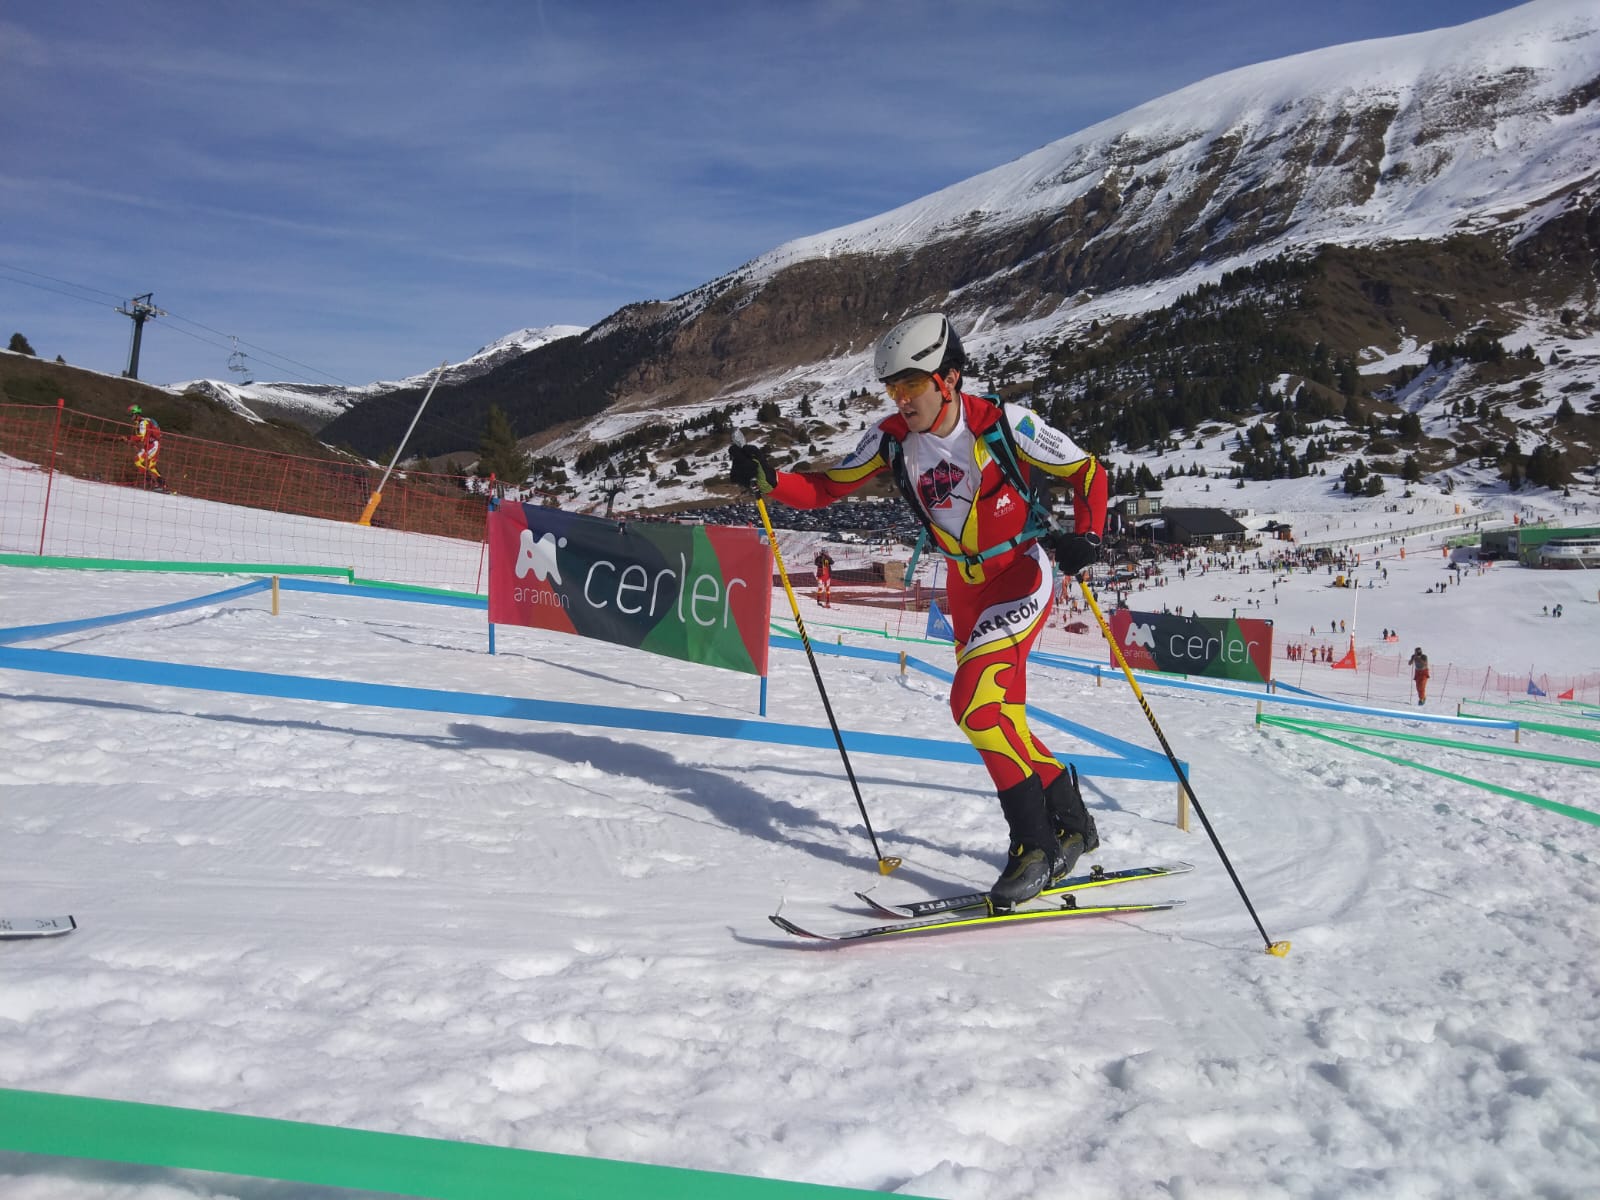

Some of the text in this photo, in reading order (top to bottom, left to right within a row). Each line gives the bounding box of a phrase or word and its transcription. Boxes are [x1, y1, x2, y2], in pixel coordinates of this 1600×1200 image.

[513, 587, 570, 609] aramon
[584, 552, 747, 629] cerler
[970, 598, 1039, 642] ARAGÓN
[1124, 648, 1157, 660] aramon
[1169, 630, 1260, 664] cerler
